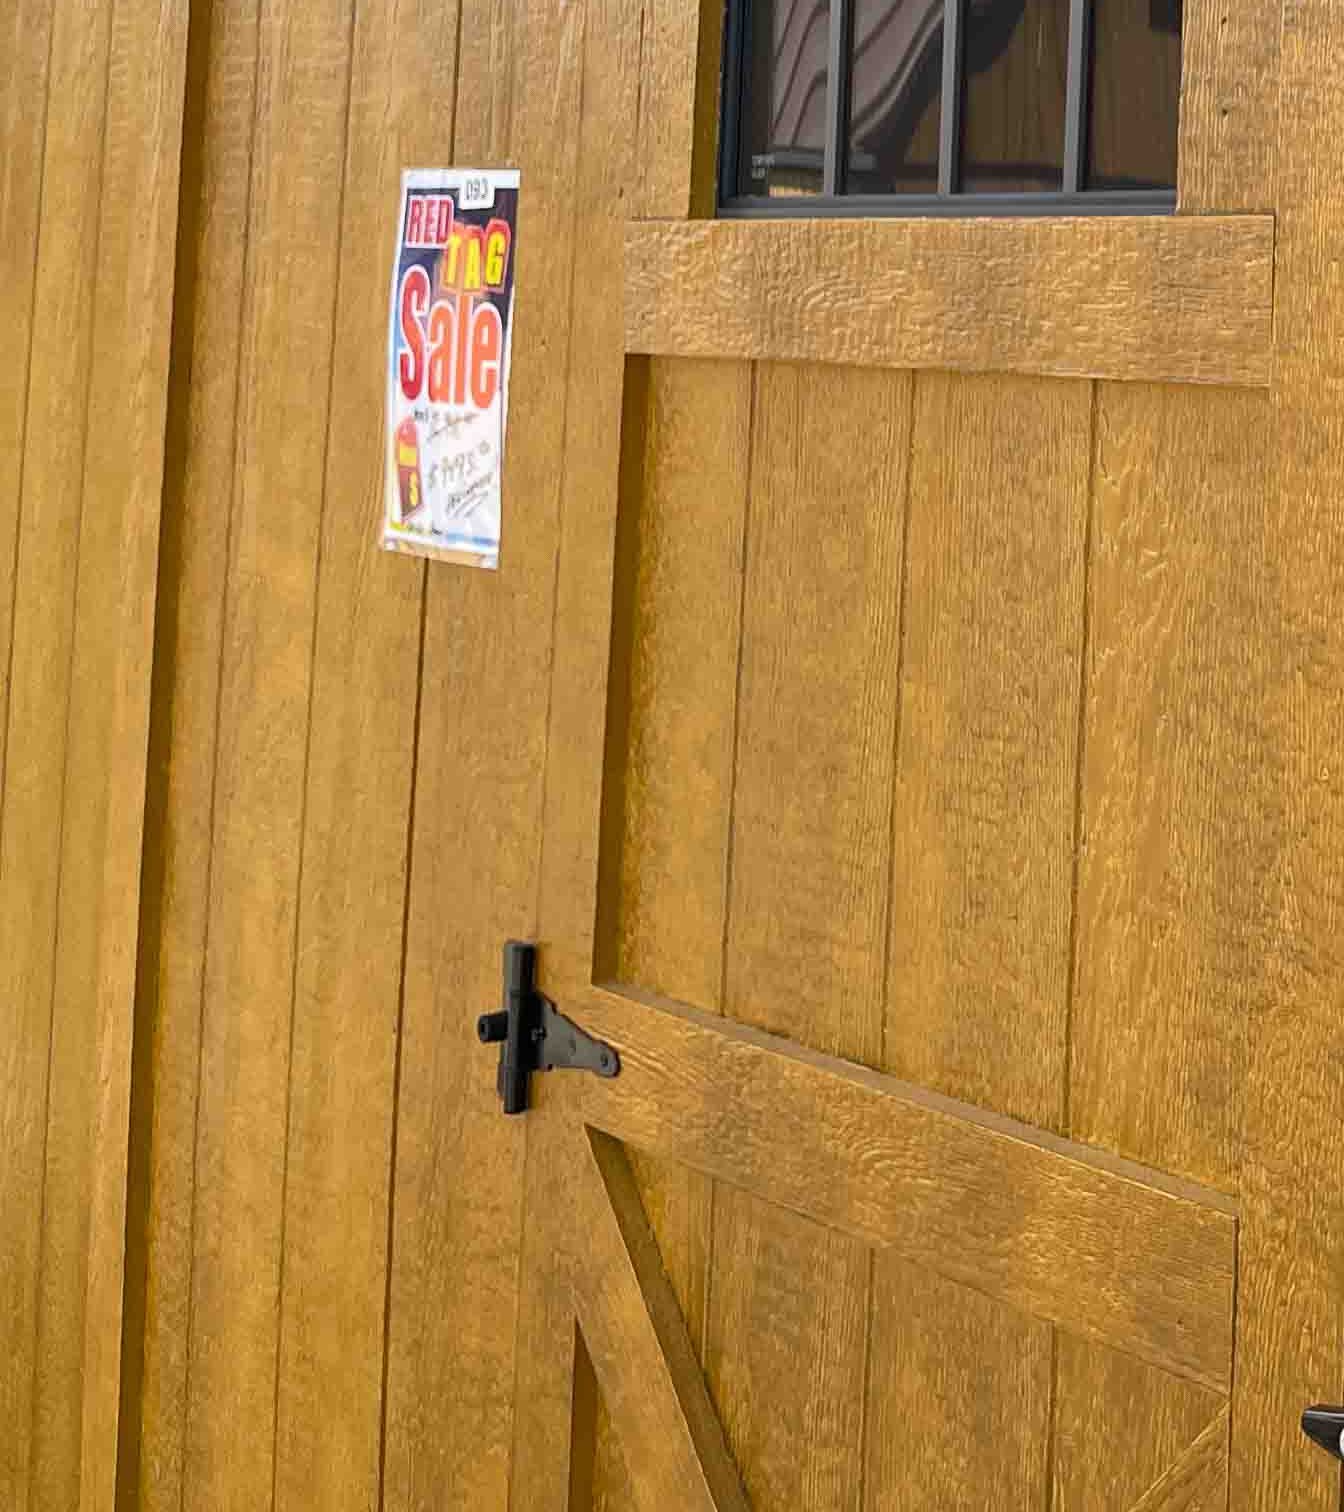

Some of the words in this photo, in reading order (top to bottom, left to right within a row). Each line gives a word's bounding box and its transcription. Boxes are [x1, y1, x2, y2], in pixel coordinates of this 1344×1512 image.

[407, 197, 453, 246] RED
[445, 229, 507, 291] TAG
[399, 266, 502, 410] Sale
